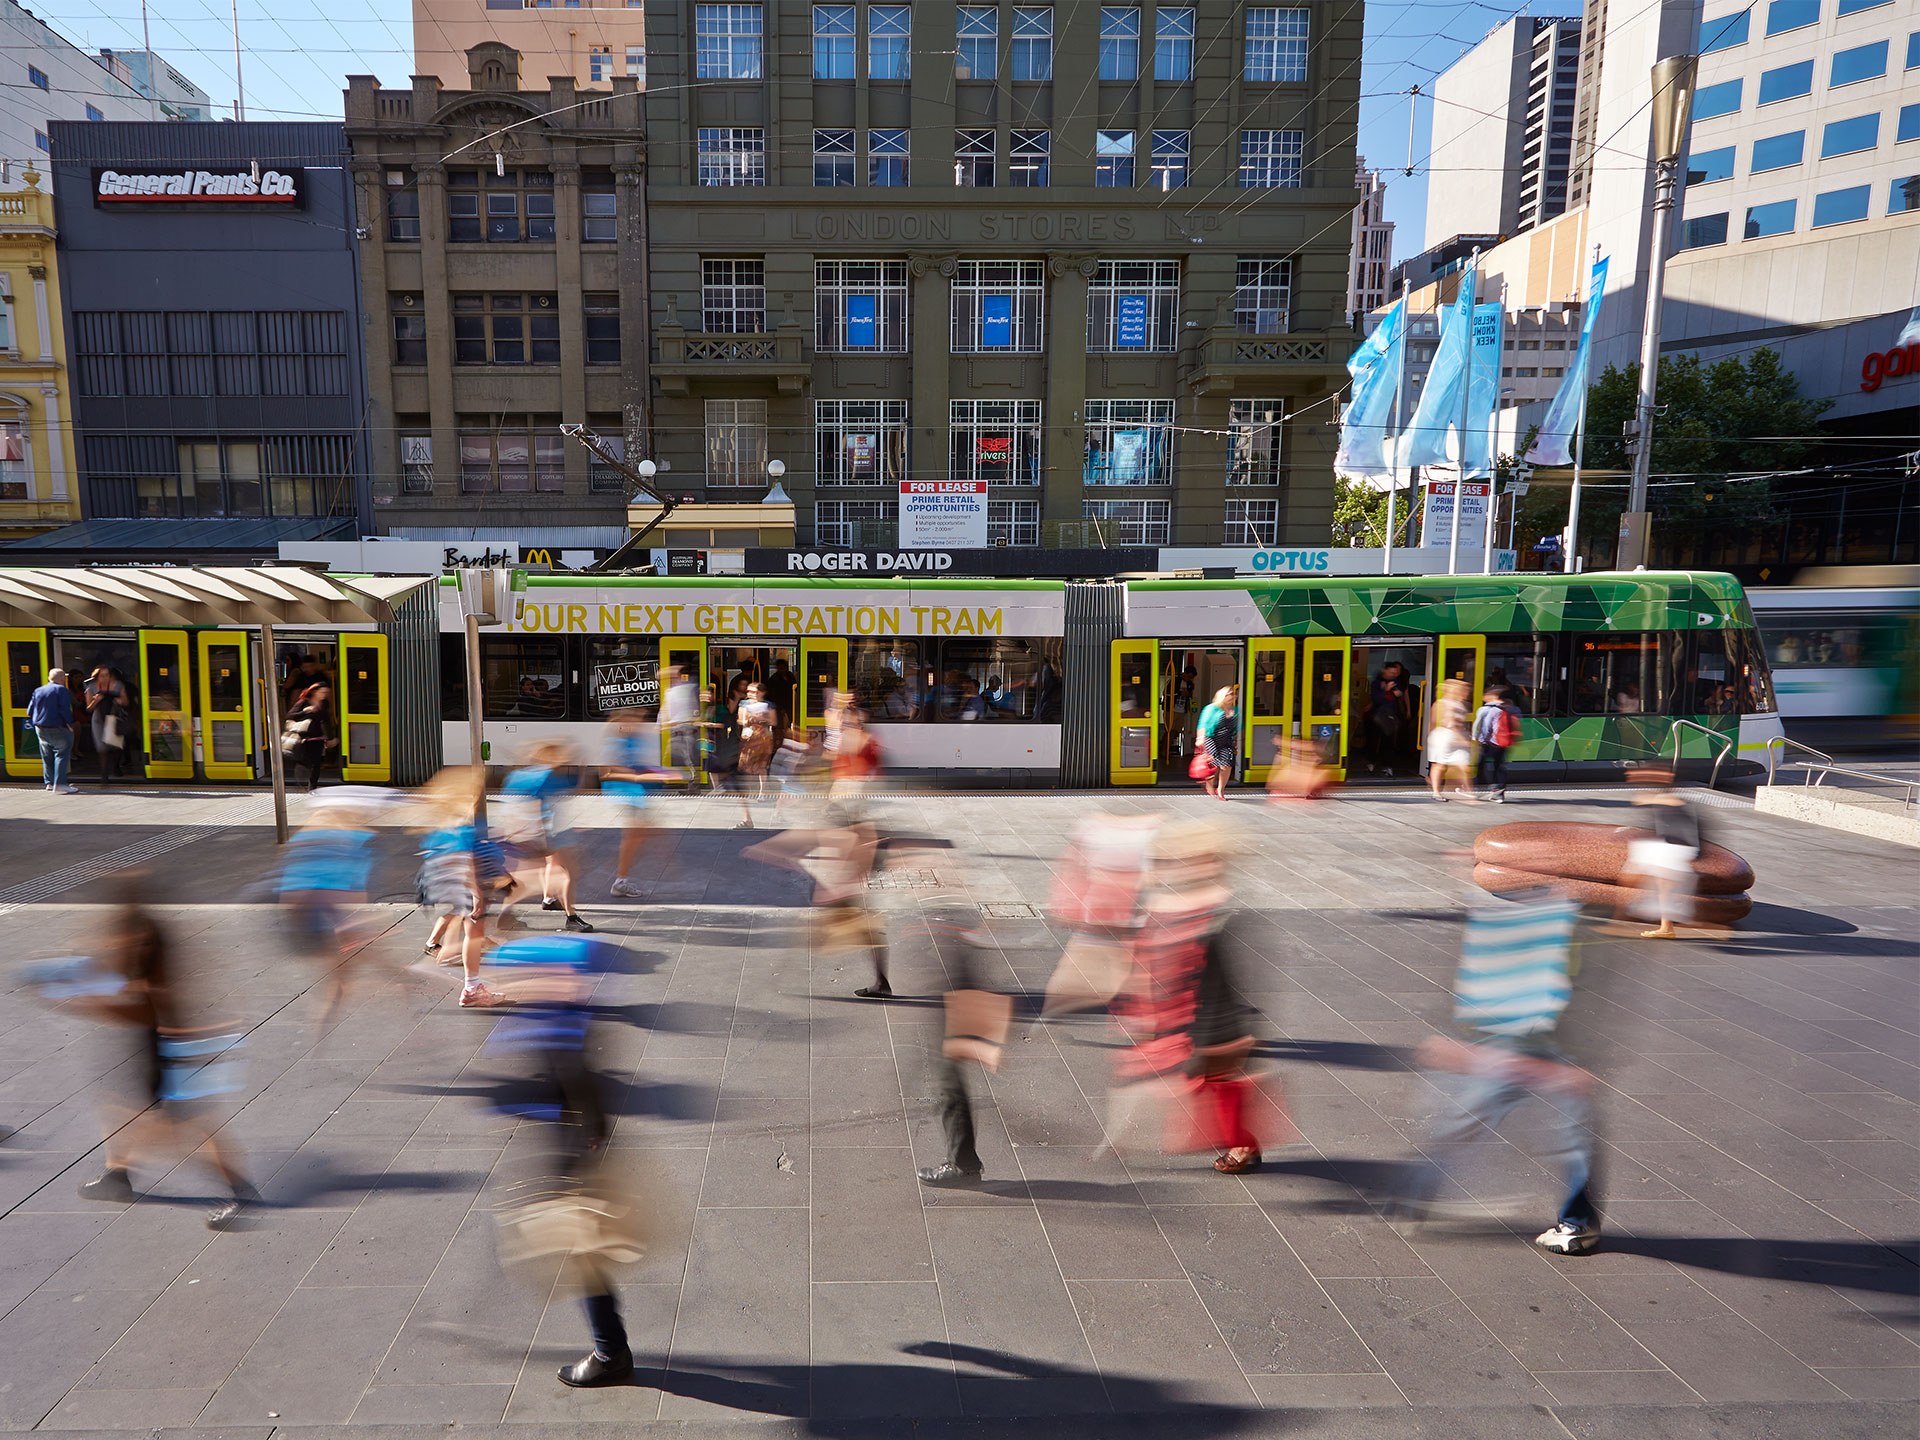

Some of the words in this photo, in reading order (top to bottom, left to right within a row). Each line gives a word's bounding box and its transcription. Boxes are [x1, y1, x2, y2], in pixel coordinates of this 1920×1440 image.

[100, 171, 194, 195] General
[193, 171, 258, 195] Pants
[260, 170, 297, 196] Co.
[791, 212, 952, 240] LONDON
[979, 212, 1136, 240] STORES
[980, 450, 1007, 460] rivers
[910, 483, 935, 492] FOR
[939, 483, 976, 492] LEASE
[1435, 484, 1453, 493] FOR
[1462, 485, 1482, 494] EASE
[906, 504, 980, 512] OPPORTUNITIES
[1463, 498, 1480, 506] ETAIL
[1431, 506, 1483, 514] OPPORNITIES
[788, 553, 868, 570] ROGER
[876, 553, 952, 570] DAVID
[1252, 552, 1329, 570] OPTUS
[508, 605, 587, 632] OUR
[600, 605, 684, 633] NEXT
[694, 605, 900, 634] GENERATION
[911, 607, 1002, 635] TRAM
[598, 664, 650, 684] MADE
[600, 680, 660, 695] MELBOURN
[601, 699, 619, 708] FOR
[620, 694, 660, 705] MELBOUR
